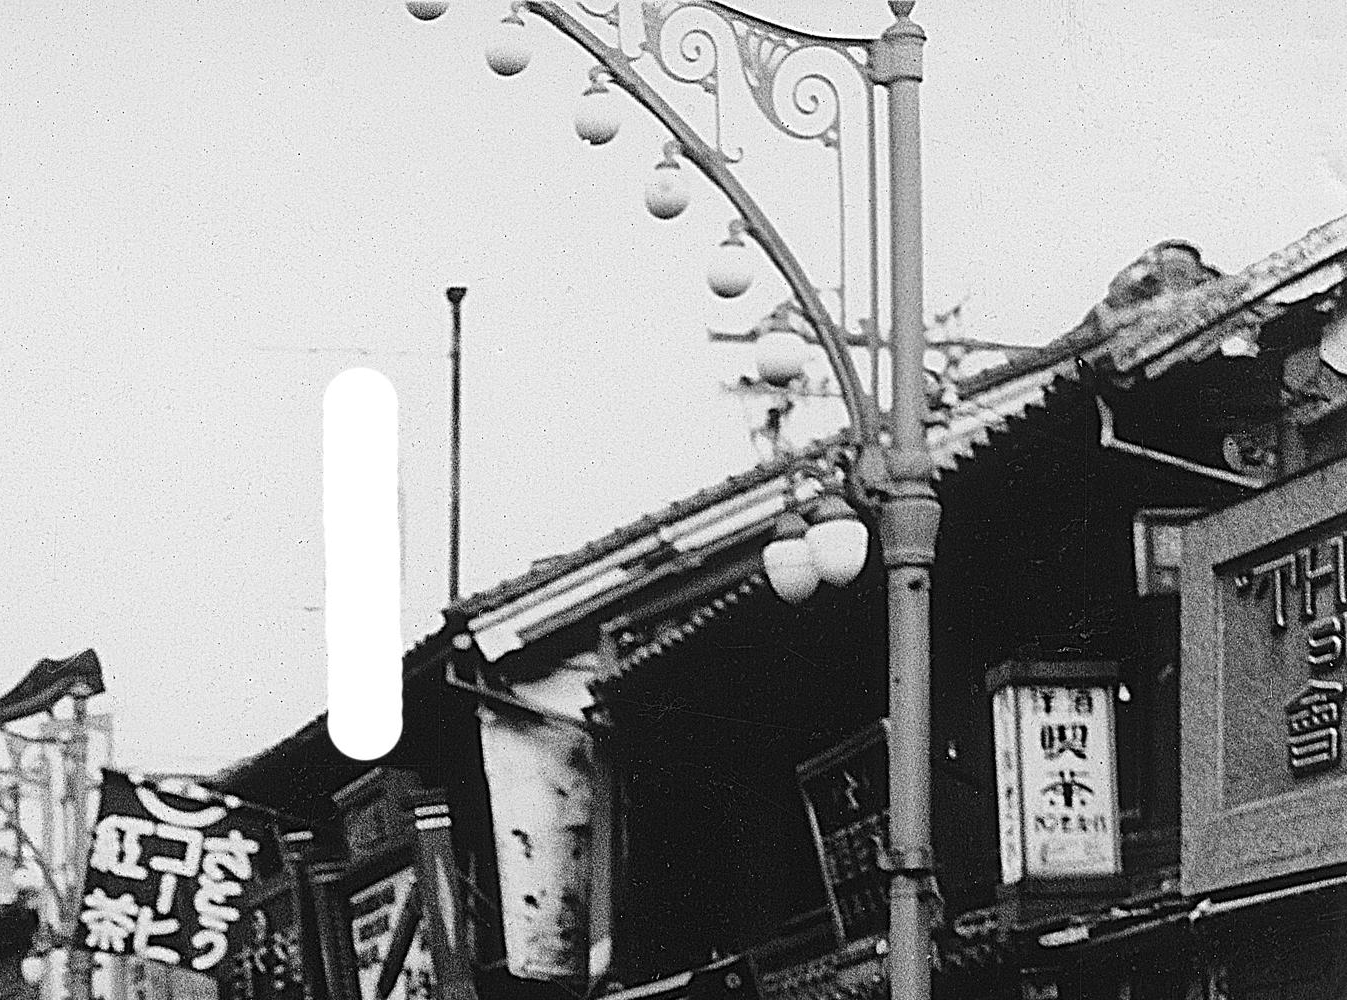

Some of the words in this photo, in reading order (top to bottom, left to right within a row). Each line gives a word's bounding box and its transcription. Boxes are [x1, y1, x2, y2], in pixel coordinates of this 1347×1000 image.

[1234, 535, 1347, 626] "TH
[1040, 723, 1095, 808] 喫茶
[81, 813, 155, 952] 紅茶
